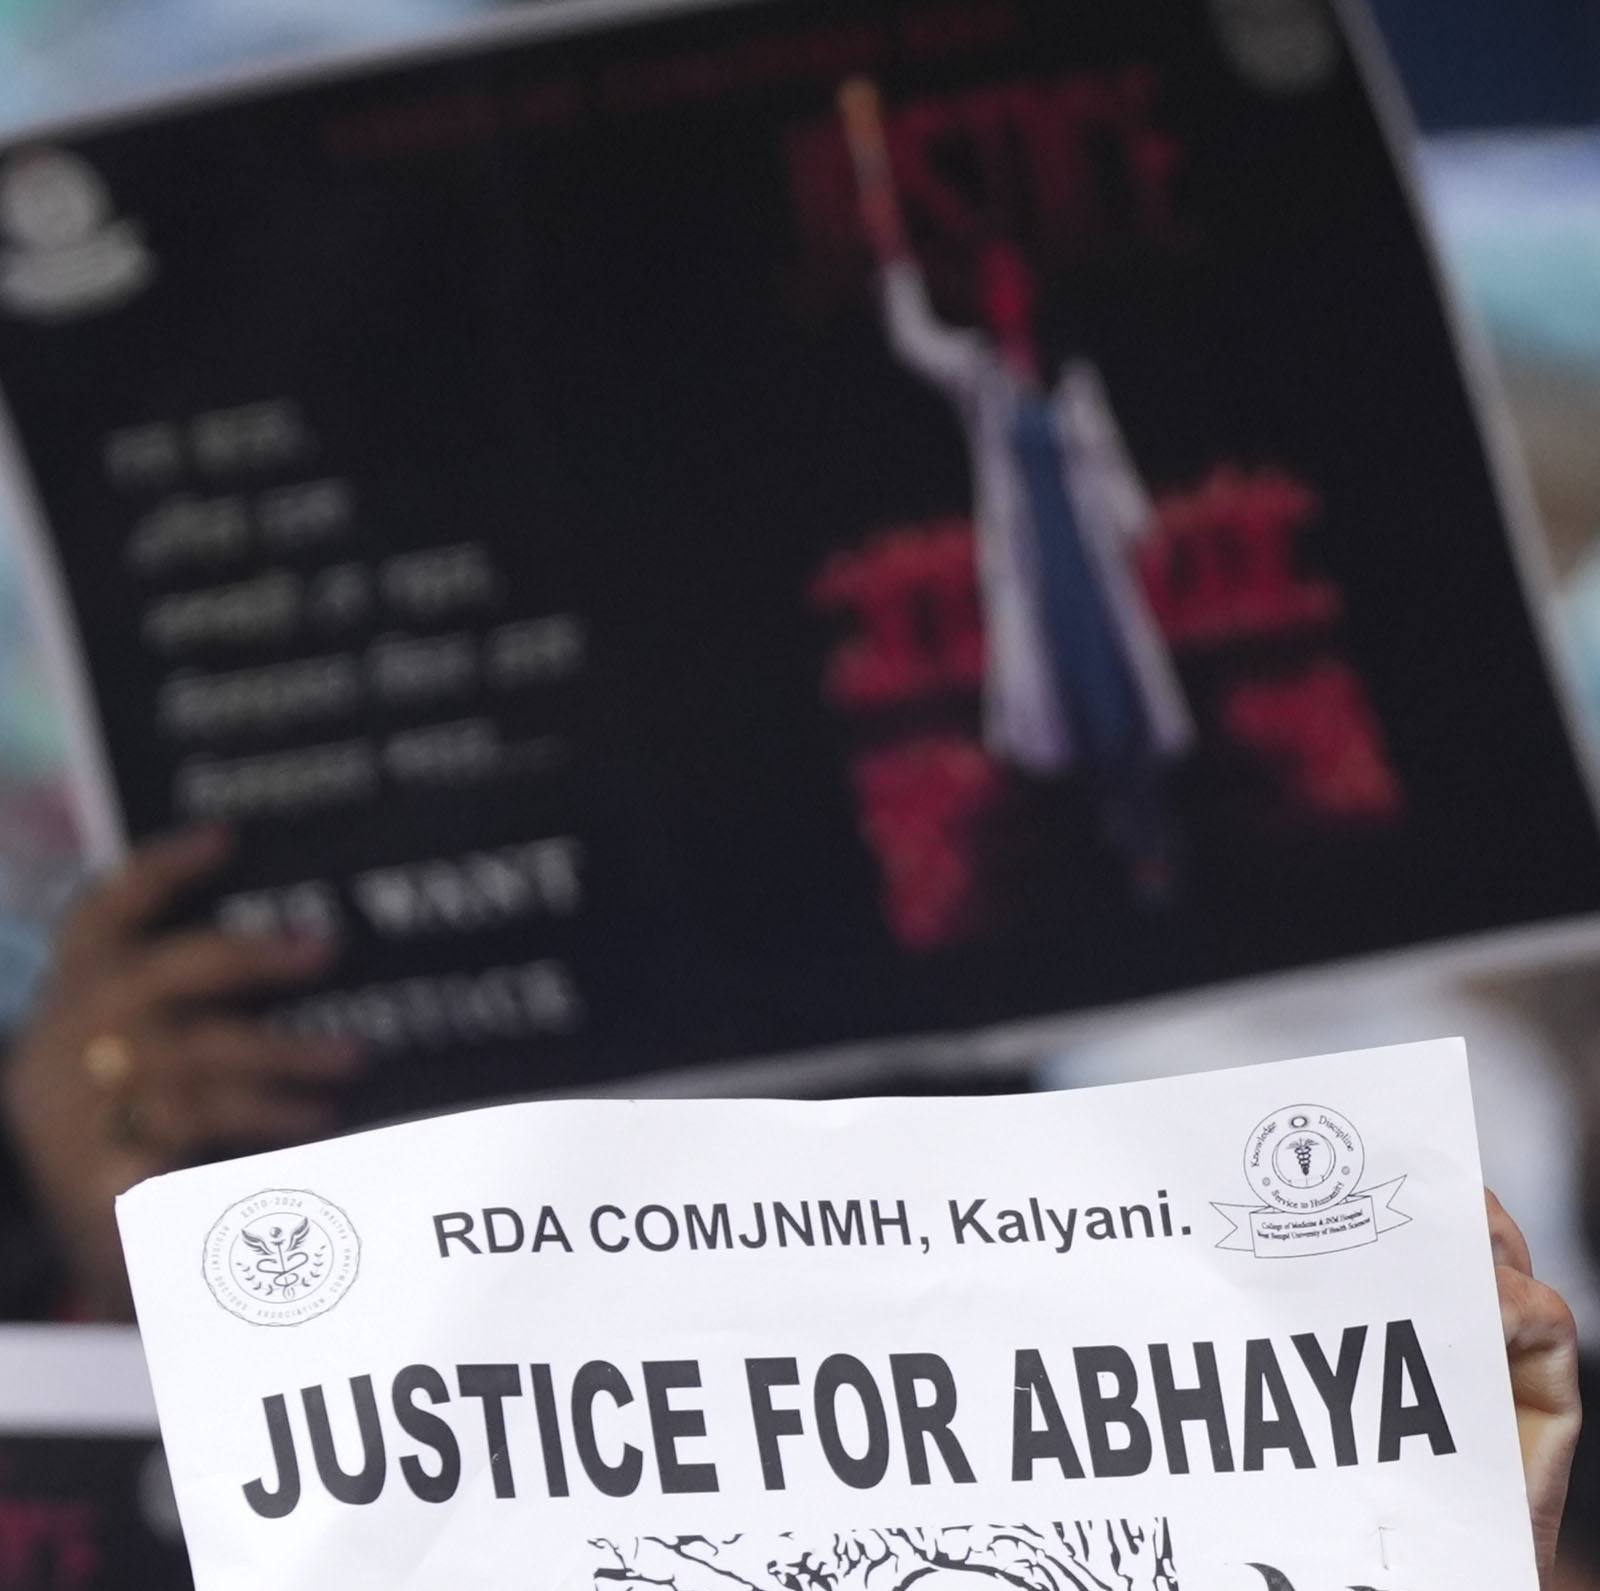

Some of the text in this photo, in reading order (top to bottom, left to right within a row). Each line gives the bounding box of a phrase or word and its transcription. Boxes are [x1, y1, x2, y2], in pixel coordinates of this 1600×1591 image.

[352, 834, 588, 938] WANT
[1251, 1115, 1354, 1168] Knowledge Discipline
[432, 1188, 1193, 1259] RDA COMJNMH, Kalyani.
[241, 1318, 1458, 1520] JUSTICE FOR ABHAYA
